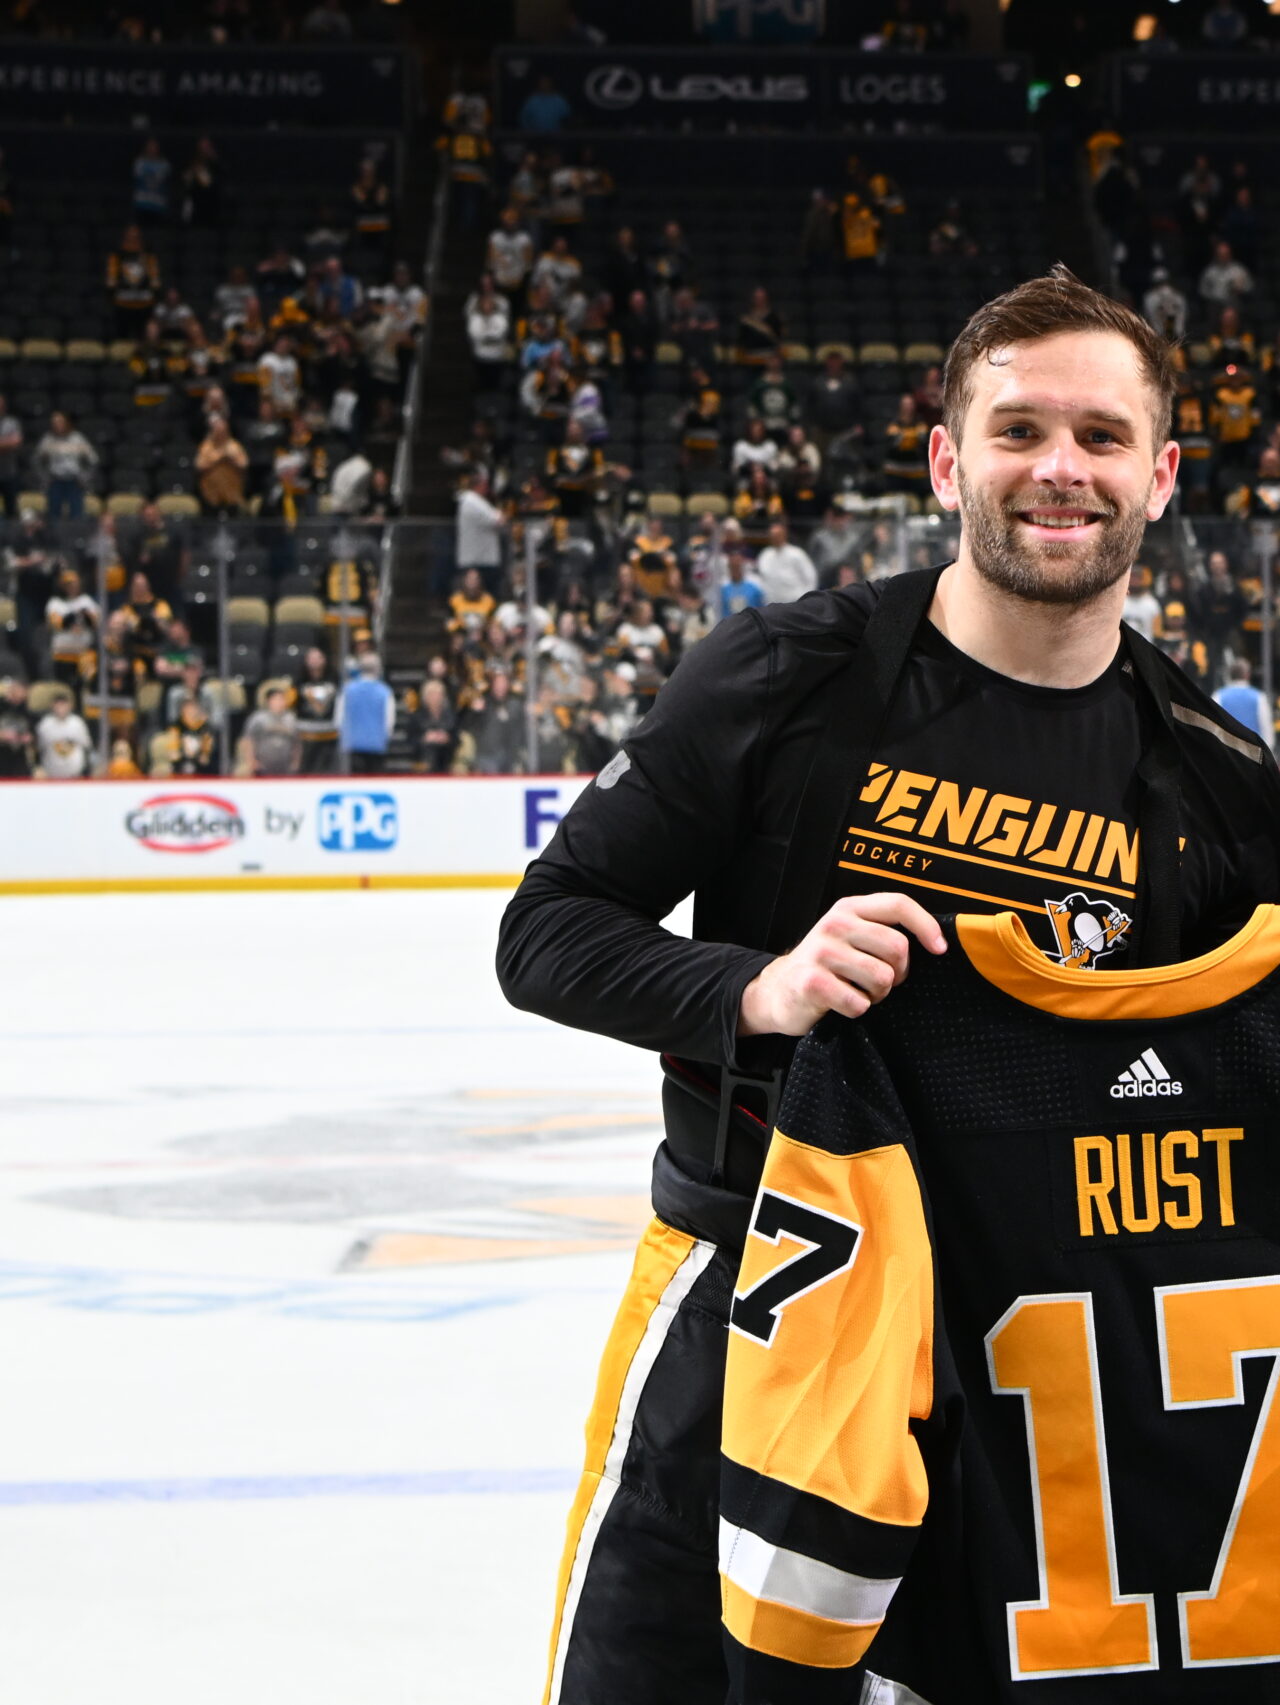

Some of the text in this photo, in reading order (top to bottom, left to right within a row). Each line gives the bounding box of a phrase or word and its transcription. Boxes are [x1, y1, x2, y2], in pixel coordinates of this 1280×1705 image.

[177, 69, 324, 98] AMAZING
[650, 73, 809, 101] LEXUS
[838, 73, 946, 104] LOGES
[125, 796, 397, 849] Glidden by PPG
[859, 761, 1186, 886] ENGUIN
[1110, 1077, 1183, 1099] adidas
[1073, 1127, 1244, 1237] RUST
